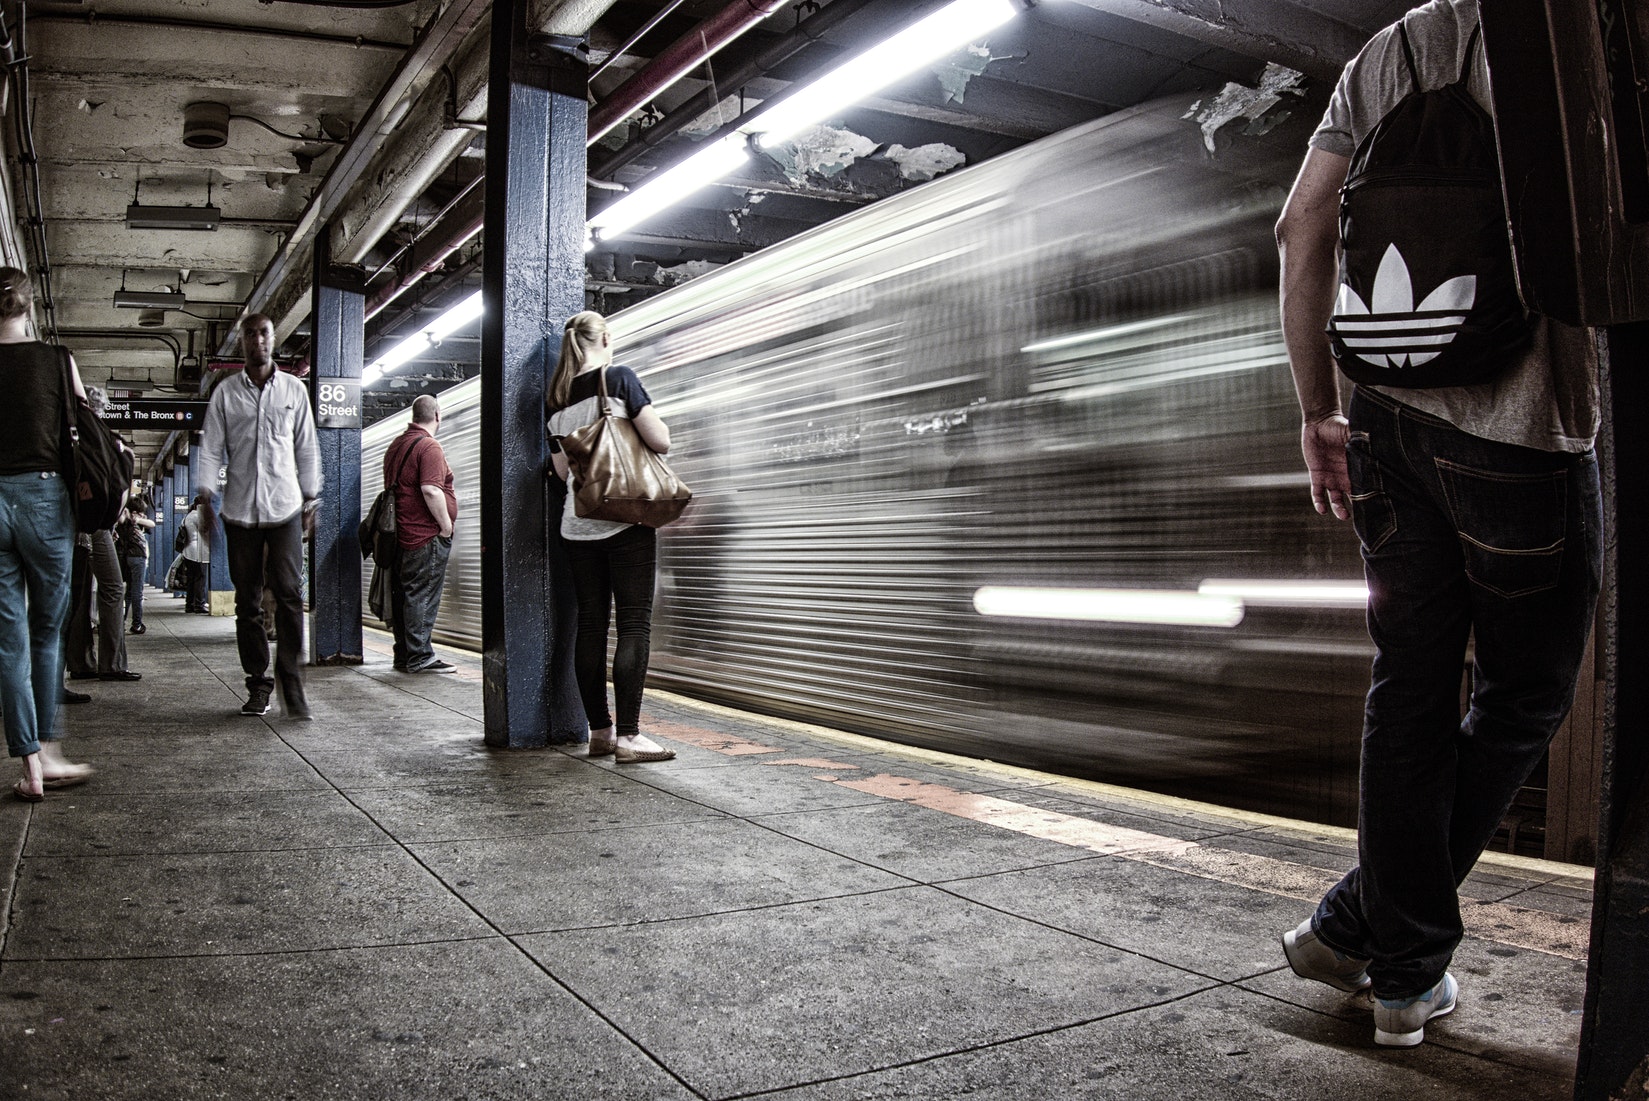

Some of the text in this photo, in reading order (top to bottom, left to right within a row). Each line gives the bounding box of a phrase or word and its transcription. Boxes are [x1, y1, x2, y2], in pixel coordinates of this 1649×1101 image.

[319, 384, 346, 402] 86
[124, 411, 131, 419] &
[133, 411, 149, 419] The
[150, 411, 175, 419] Bronx
[318, 403, 358, 417] Street
[174, 497, 185, 505] 86
